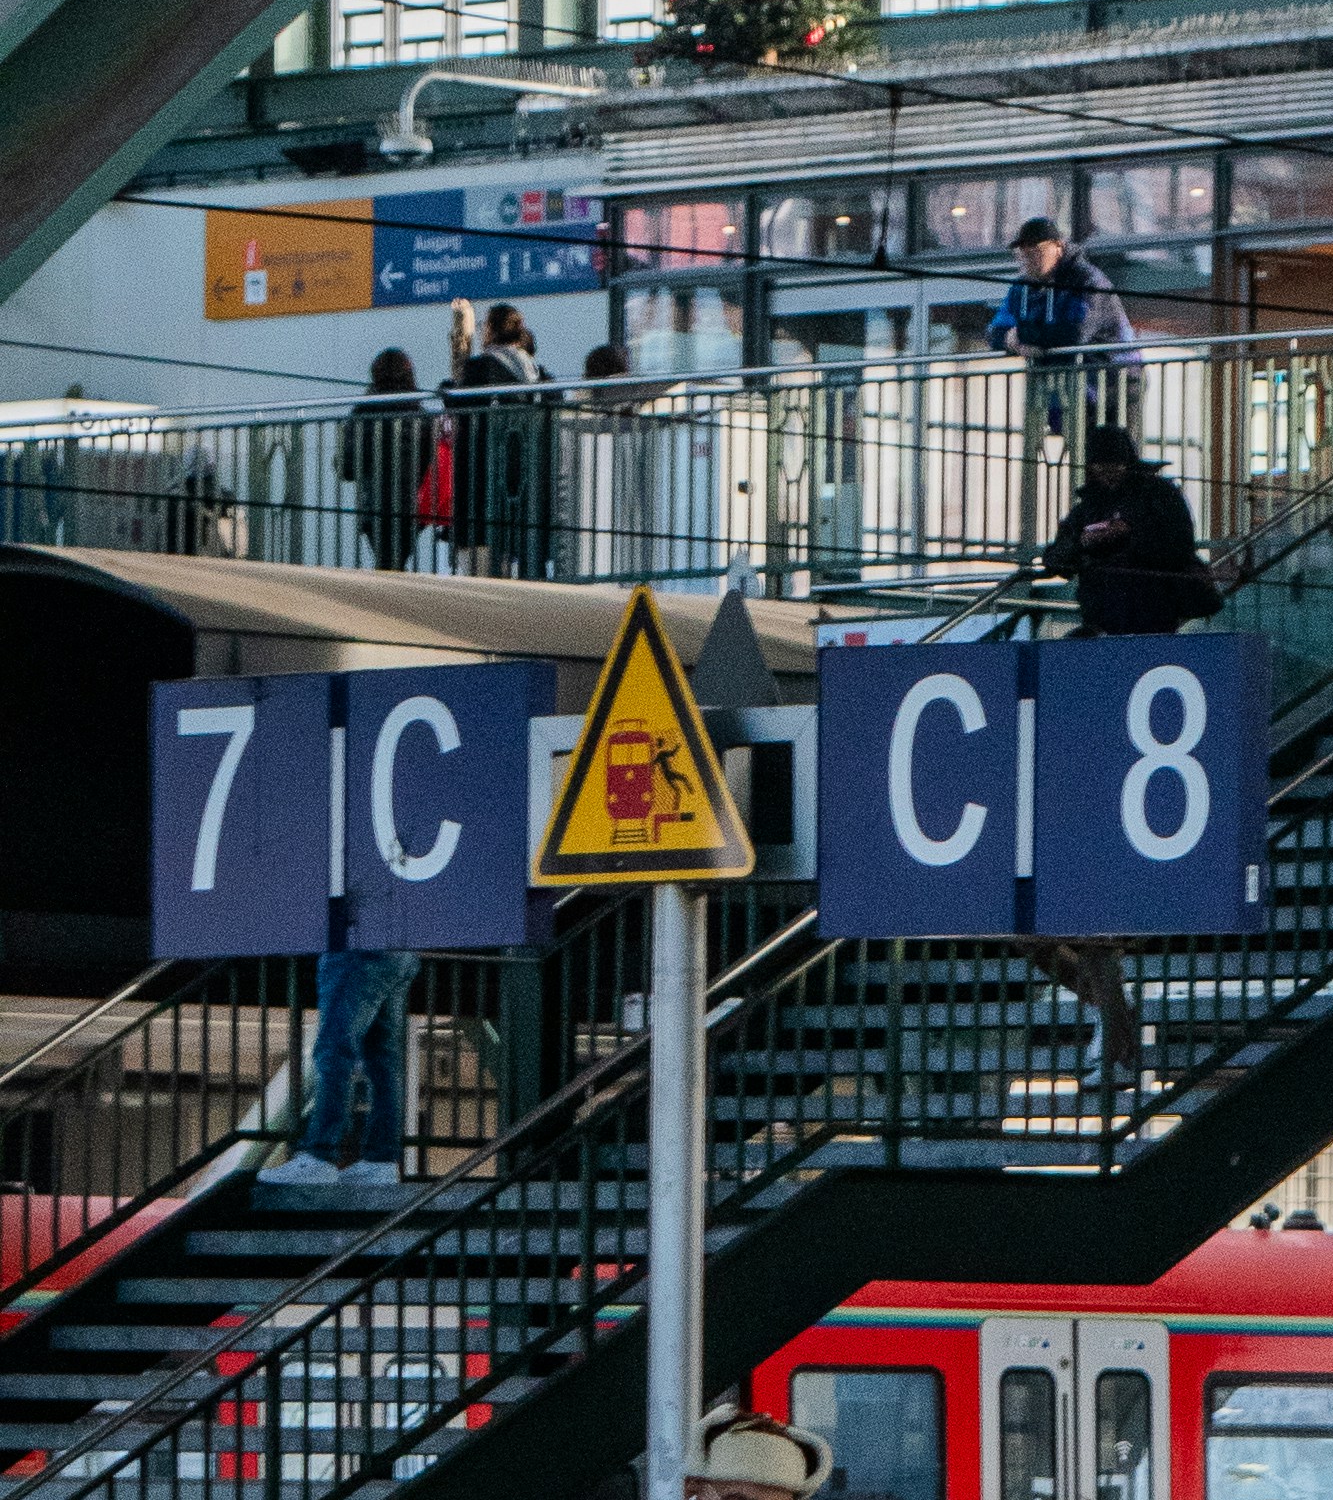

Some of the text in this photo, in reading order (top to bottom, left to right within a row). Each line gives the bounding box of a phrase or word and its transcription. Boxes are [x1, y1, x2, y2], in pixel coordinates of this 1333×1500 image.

[176, 696, 462, 892] 7 C
[887, 665, 1211, 867] C 8
